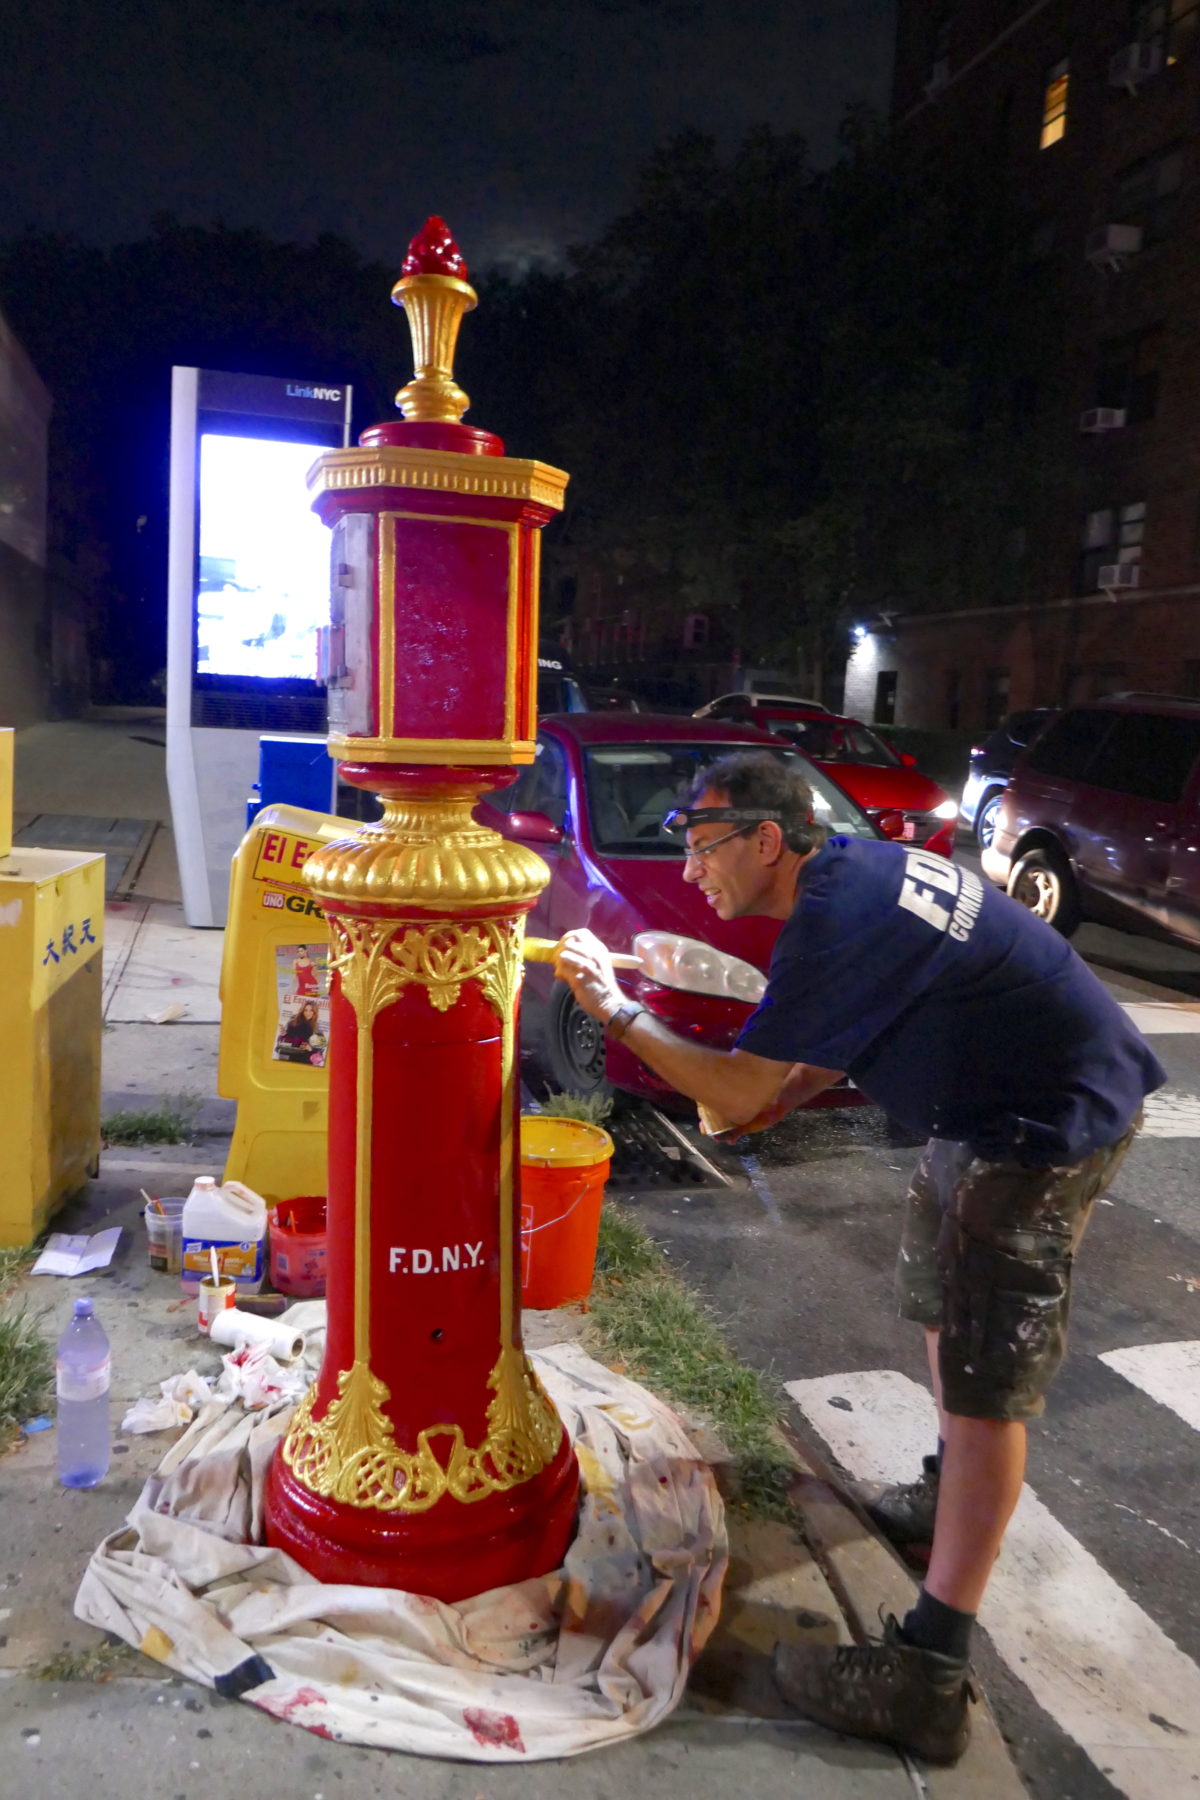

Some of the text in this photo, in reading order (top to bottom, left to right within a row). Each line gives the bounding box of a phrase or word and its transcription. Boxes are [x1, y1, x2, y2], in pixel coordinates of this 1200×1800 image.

[286, 384, 341, 402] LinkNYC
[290, 840, 315, 869] E
[263, 892, 284, 909] UNO
[389, 1240, 485, 1274] F.D.N.Y.
